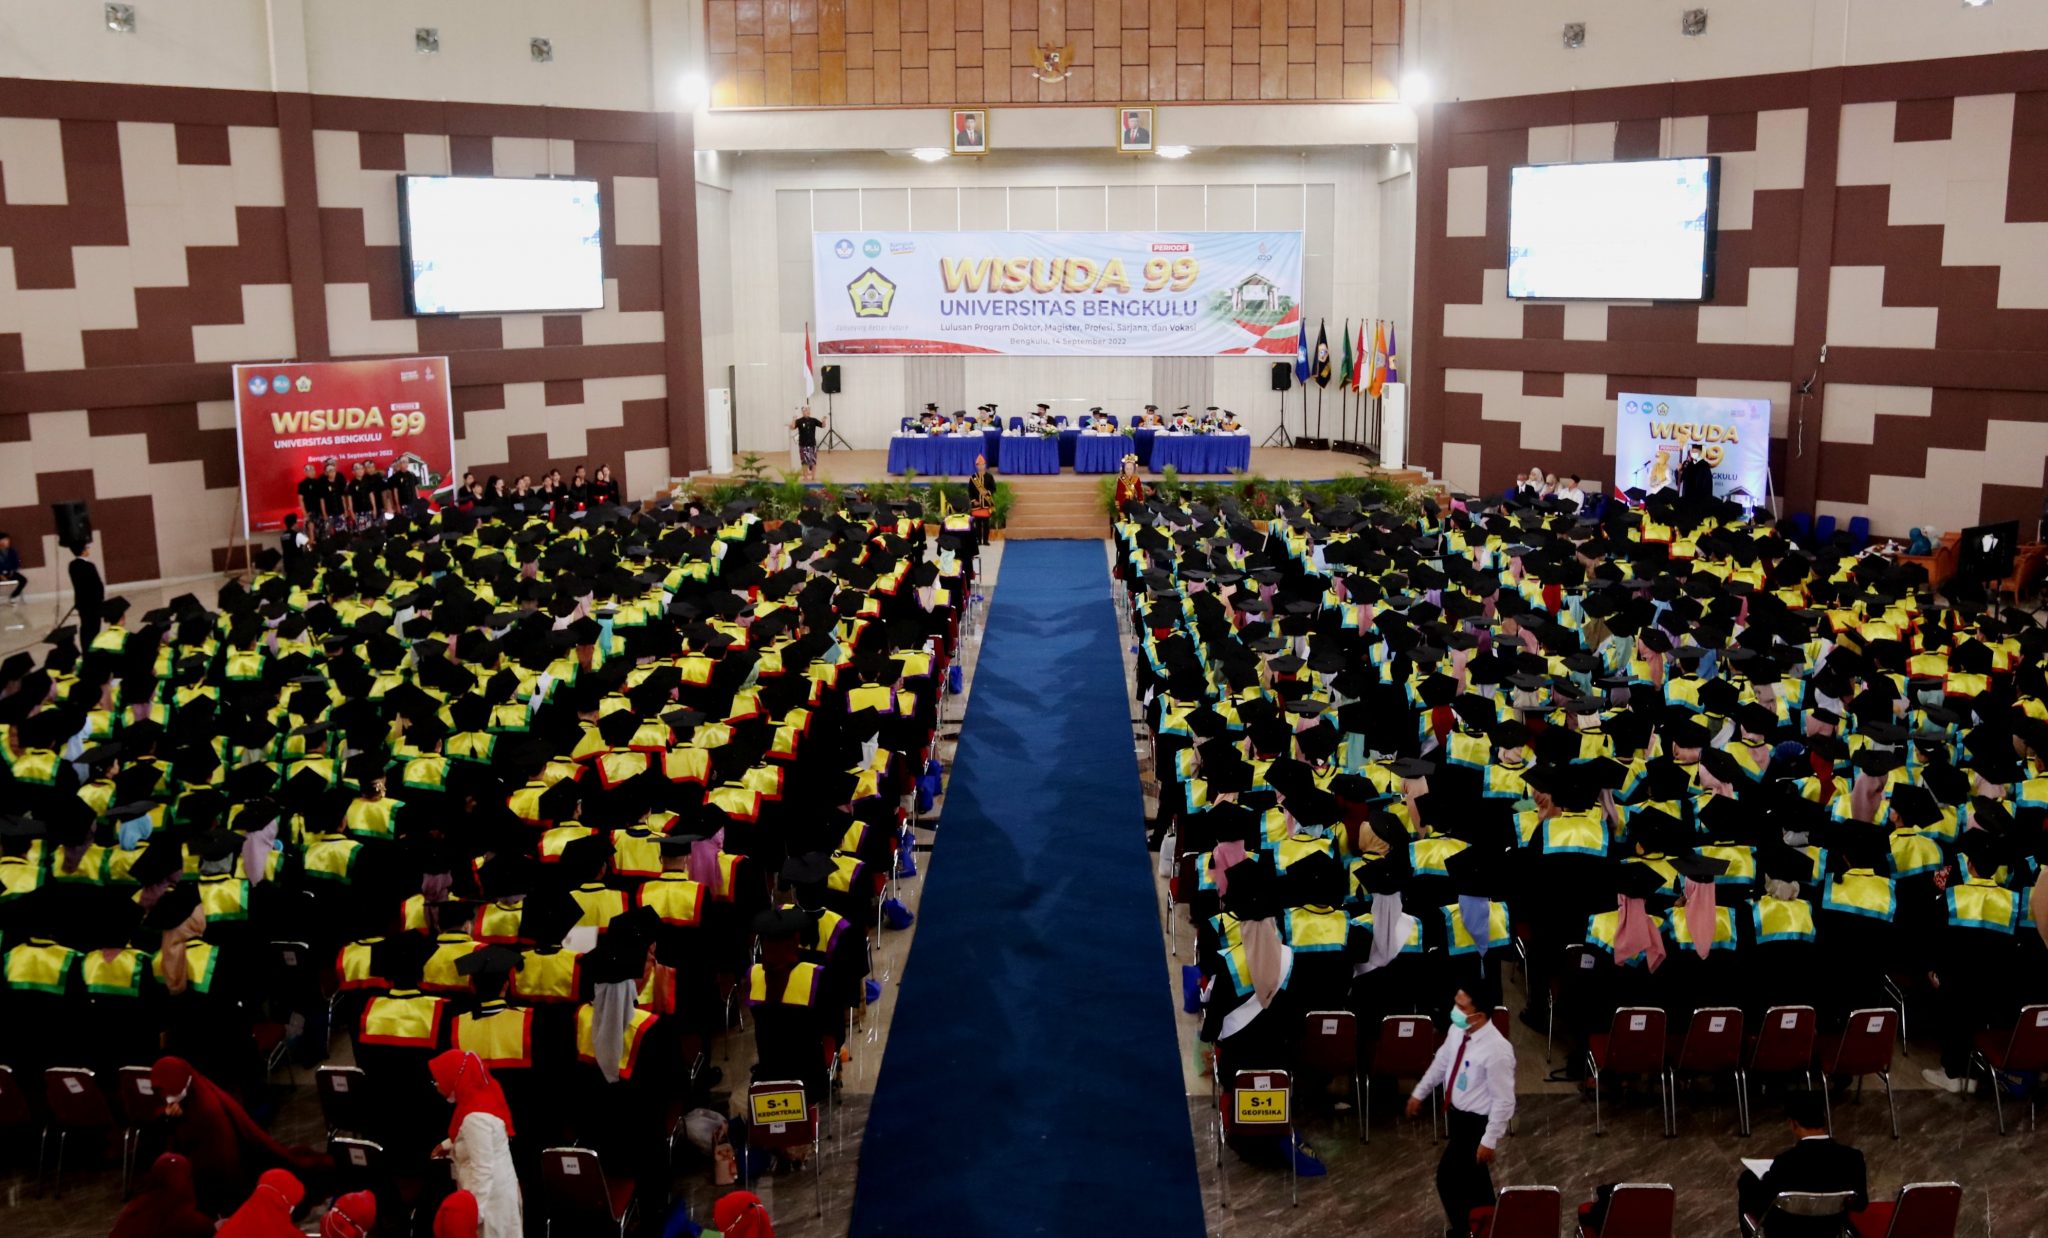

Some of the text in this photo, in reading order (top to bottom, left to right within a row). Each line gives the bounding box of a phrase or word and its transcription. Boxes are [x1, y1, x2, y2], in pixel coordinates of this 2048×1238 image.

[1153, 244, 1188, 252] PERIODE
[940, 256, 1200, 294] WISUDA 99
[940, 299, 1197, 316] UNIVERSITAS BENGKULU
[941, 323, 972, 331] Lulusan
[974, 323, 1010, 333] Program
[1012, 323, 1043, 333] Doktor,
[1045, 324, 1082, 334] Magister,
[1085, 323, 1115, 333] Profesi,
[1117, 323, 1150, 334] Sarjana,
[1152, 323, 1168, 331] dan
[1010, 337, 1050, 346] Bengkulu,
[1063, 337, 1106, 347] September
[1108, 337, 1127, 345] 2022
[271, 406, 426, 438] WISUDA 99
[1649, 421, 1739, 444] WISUDA
[274, 433, 382, 449] UNIVERSITAS BENGKULU
[347, 451, 378, 461] September
[1712, 472, 1738, 480] GKULU
[767, 1098, 789, 1109] S-1
[1251, 1097, 1272, 1107] S-1
